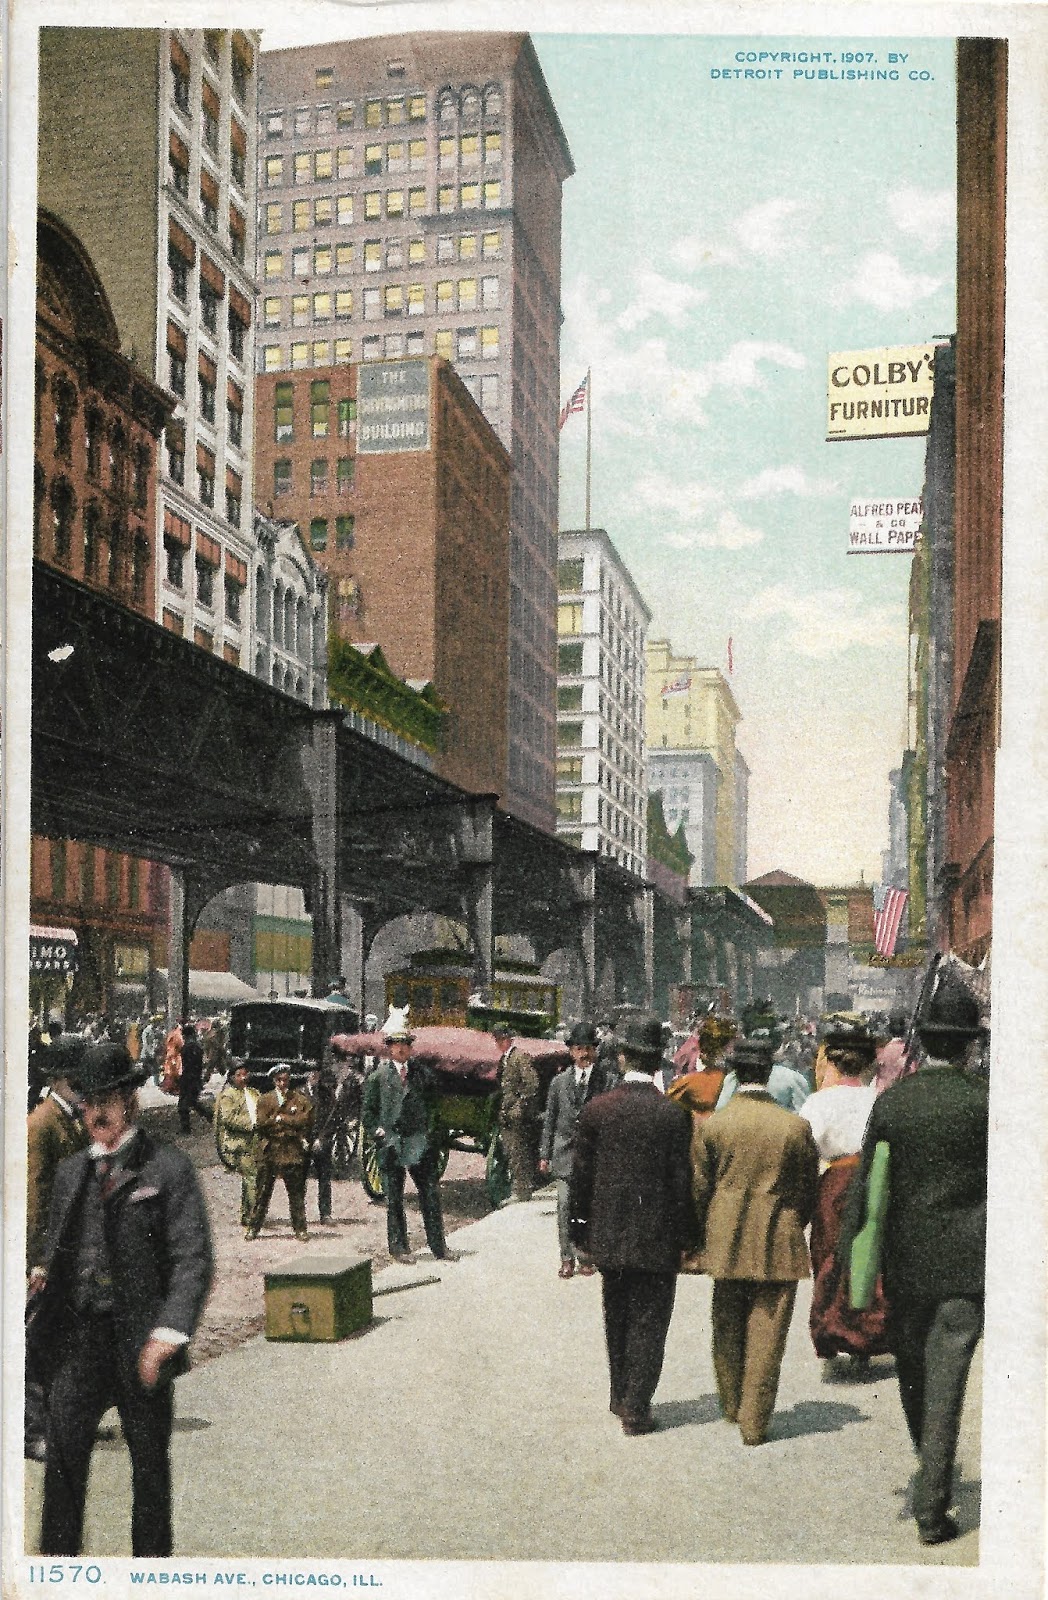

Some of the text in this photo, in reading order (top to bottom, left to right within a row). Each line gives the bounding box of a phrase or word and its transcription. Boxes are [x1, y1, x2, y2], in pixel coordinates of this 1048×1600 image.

[382, 371, 407, 384] THE
[830, 396, 934, 421] FURNITUR
[362, 421, 425, 441] BUILDING
[850, 503, 893, 517] ALFRED
[849, 531, 882, 545] WALL
